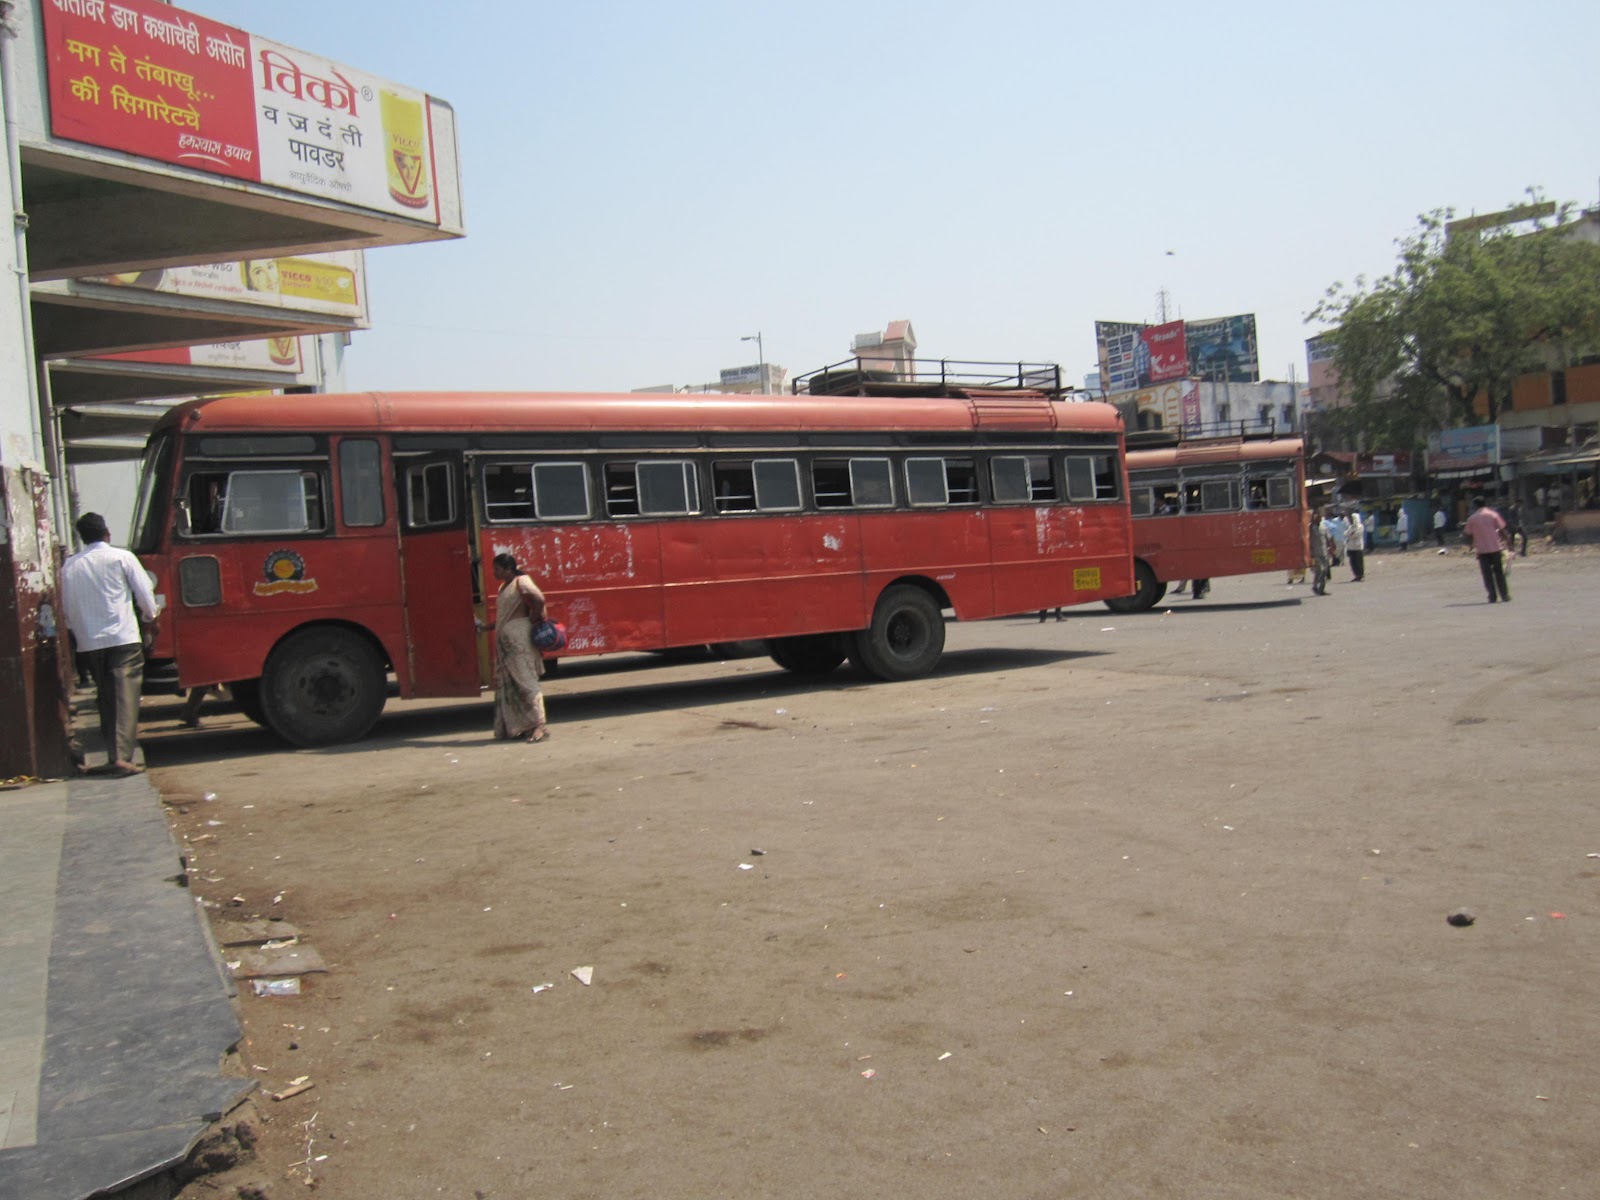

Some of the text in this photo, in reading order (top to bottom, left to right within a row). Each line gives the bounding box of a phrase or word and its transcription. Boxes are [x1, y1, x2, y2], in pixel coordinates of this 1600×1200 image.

[66, 39, 101, 67] मग
[108, 45, 127, 74] ते
[110, 4, 139, 34] डाग
[143, 17, 200, 53] कशाचेही
[206, 34, 245, 69] असोत
[70, 76, 201, 130] की सिगारेटचे
[259, 50, 360, 118] विको
[224, 144, 253, 162] उपाय
[288, 138, 344, 171] पावडर
